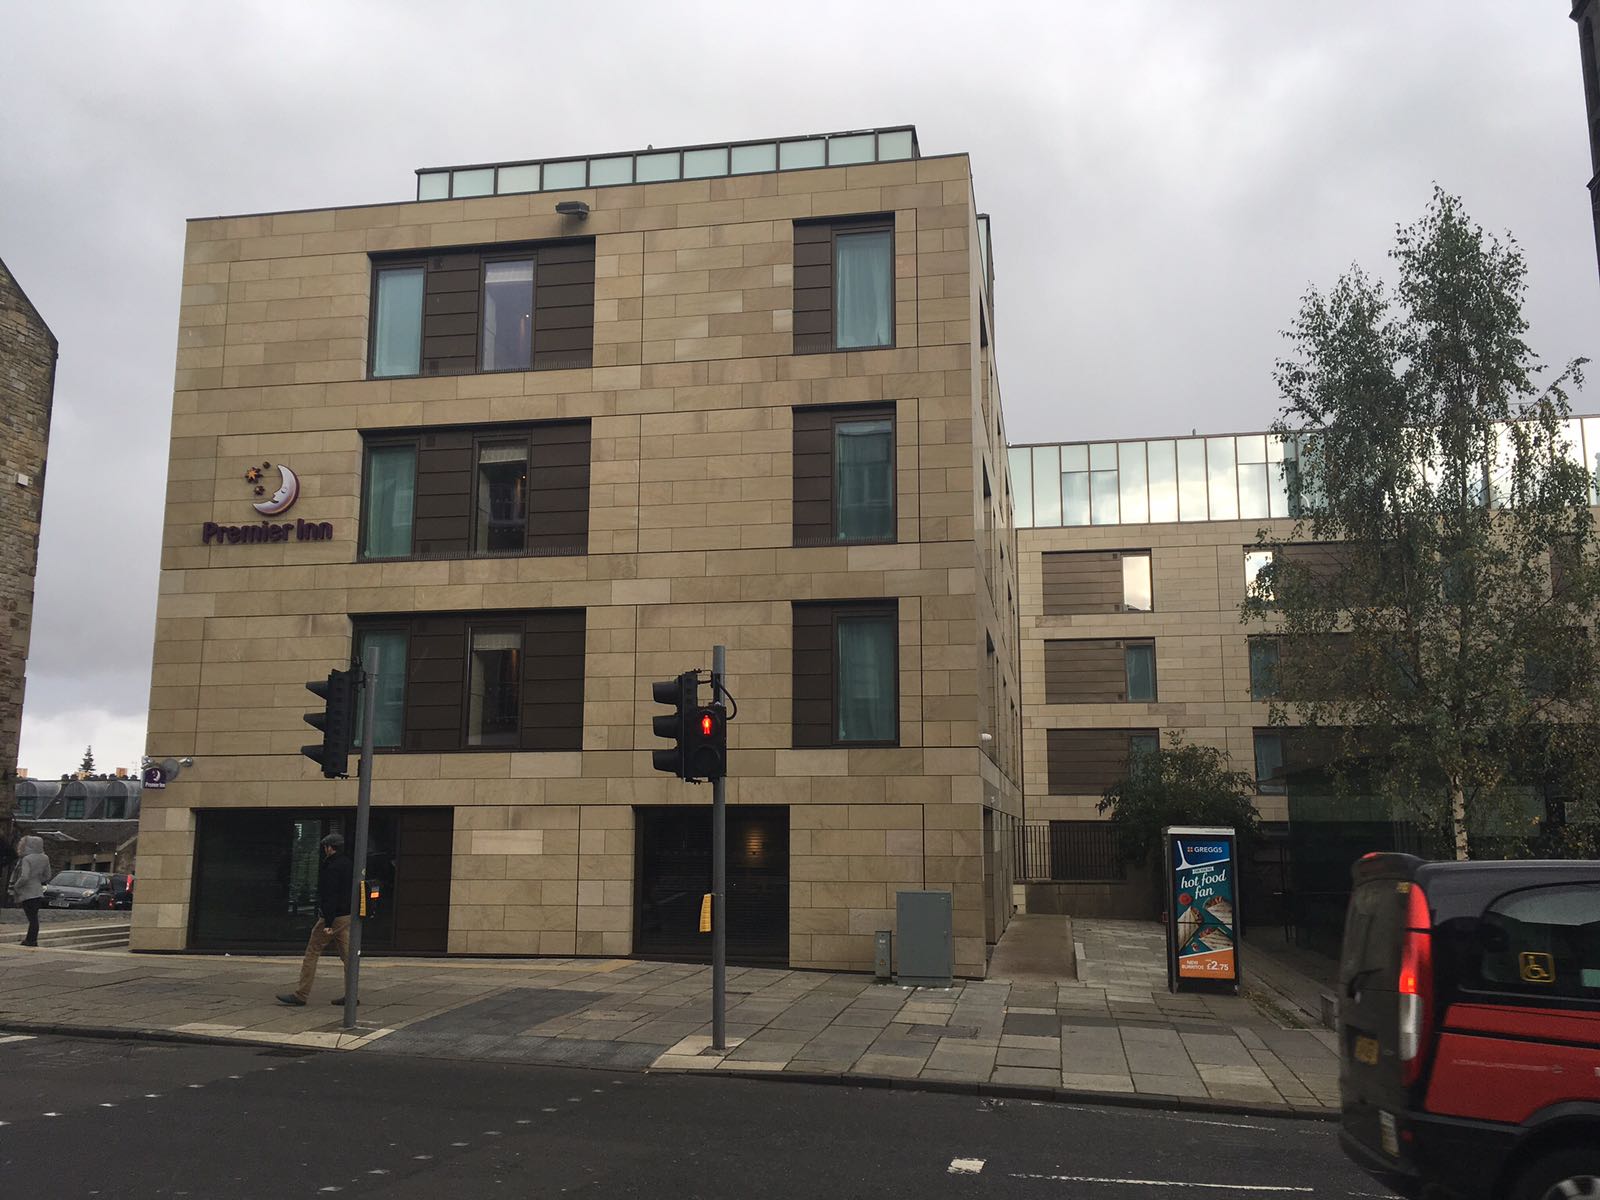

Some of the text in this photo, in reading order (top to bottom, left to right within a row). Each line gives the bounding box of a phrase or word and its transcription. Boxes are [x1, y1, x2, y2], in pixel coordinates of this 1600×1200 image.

[202, 518, 333, 544] Premier Inn
[1181, 876, 1199, 889] hot
[1201, 869, 1227, 886] food
[1195, 885, 1214, 900] fan
